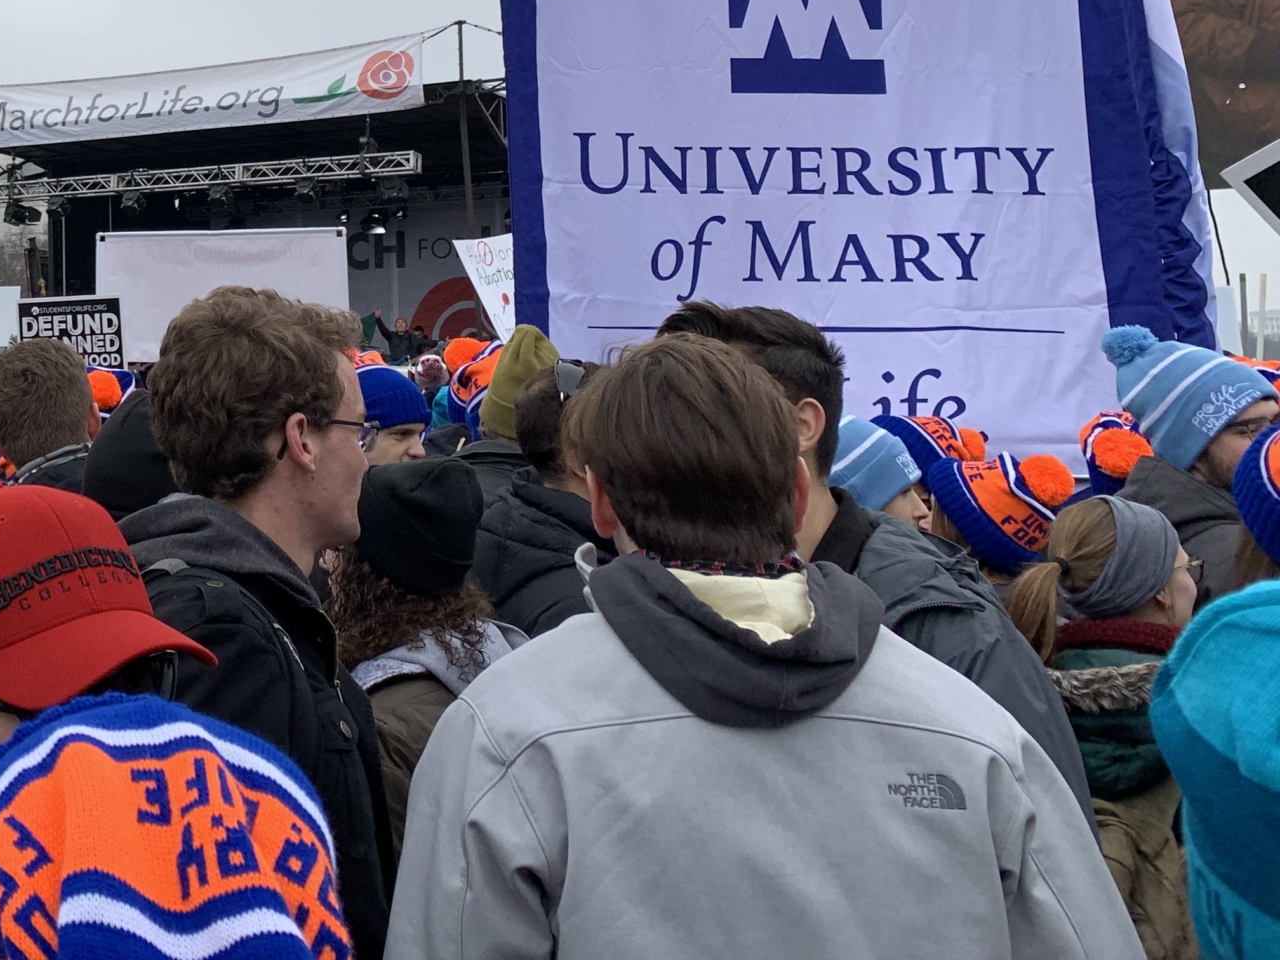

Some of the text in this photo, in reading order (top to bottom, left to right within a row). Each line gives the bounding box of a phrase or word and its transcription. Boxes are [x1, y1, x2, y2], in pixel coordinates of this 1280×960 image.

[573, 132, 1054, 196] UNIVERSITY
[419, 237, 459, 260] FO
[650, 216, 985, 301] of MARY
[476, 266, 514, 289] Adoptio
[39, 304, 107, 314] STUDENTSFORLIFE.ORG
[22, 312, 119, 338] DEFUND
[843, 368, 966, 420] ife
[1236, 395, 1252, 410] LIFE
[920, 421, 957, 456] LIFE
[1000, 515, 1042, 550] FOR
[19, 572, 133, 612] COLLEGE
[888, 783, 938, 797] NORTH
[907, 773, 936, 786] THE
[903, 796, 940, 809] FACE
